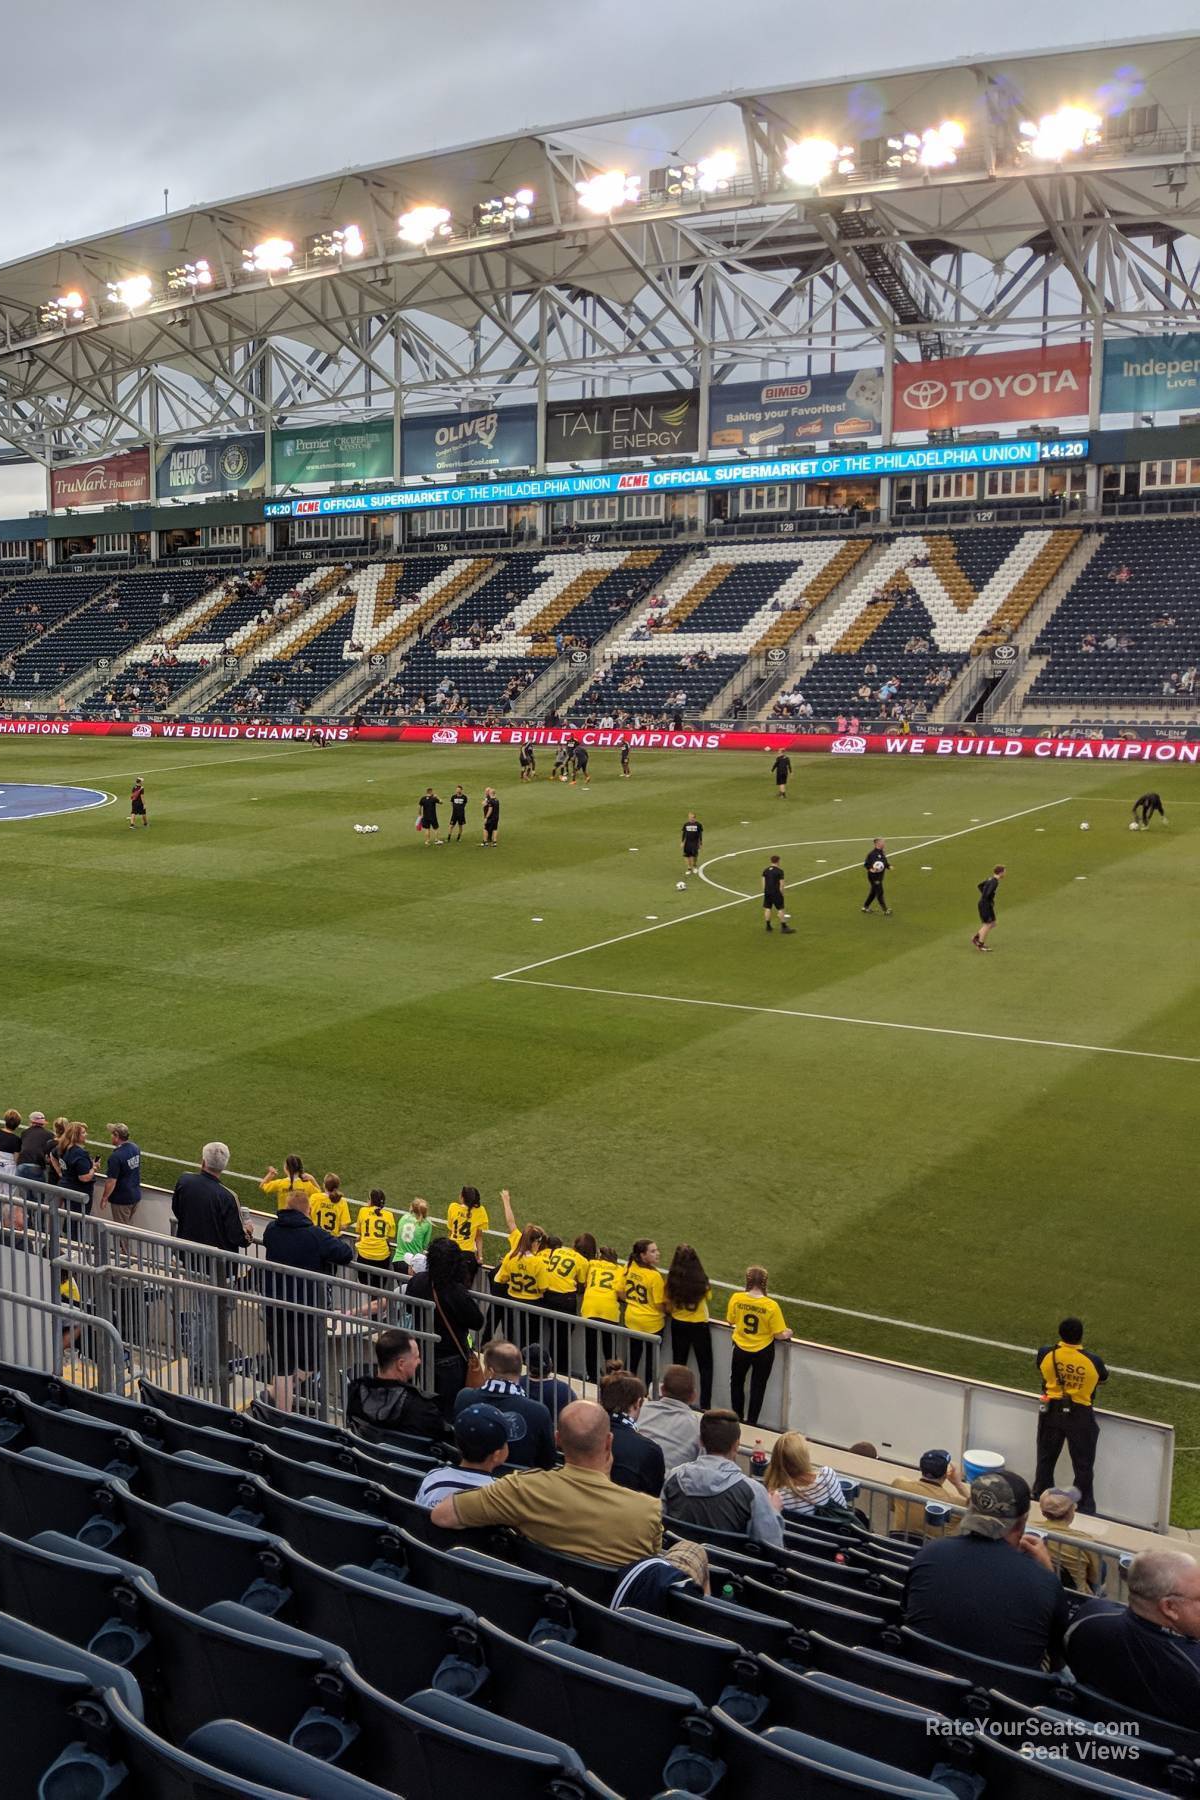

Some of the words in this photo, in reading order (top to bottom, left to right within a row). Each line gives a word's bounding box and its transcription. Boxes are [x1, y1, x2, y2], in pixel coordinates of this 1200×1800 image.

[765, 385, 808, 399] BIMBO
[951, 369, 1080, 403] TOYOTA
[1167, 379, 1197, 389] LIVE
[557, 405, 653, 438] TALEN
[726, 411, 762, 423] Baking
[764, 410, 789, 420] your
[791, 402, 847, 415] Favorites!
[435, 413, 498, 445] OLIVER
[296, 438, 329, 451] Premier
[612, 431, 682, 450] ENERGY
[169, 449, 206, 470] ACTION
[1041, 443, 1083, 458] 14:20
[55, 473, 107, 494] TruMark
[109, 477, 144, 489] Financial
[169, 466, 196, 487] NEWS
[297, 502, 319, 513] ACME
[323, 498, 367, 511] OFFICIAL
[370, 490, 449, 508] SUPERMARKET
[451, 490, 466, 501] OF
[468, 487, 490, 499] THE
[492, 478, 570, 497] PHILADELPHIA
[573, 478, 611, 491] UNION
[619, 475, 648, 488] ACME
[653, 469, 712, 485] OFFICIAL
[715, 460, 818, 481] SUPERMARKET
[821, 460, 840, 473] OF
[843, 456, 871, 471] THE
[874, 447, 978, 470] PHILADELPHIA
[982, 444, 1032, 461] UNION
[266, 506, 290, 515] 14:20
[976, 513, 992, 521] 129
[780, 524, 793, 532] 128
[301, 551, 313, 559] 125
[163, 726, 184, 736] WE
[191, 727, 239, 738] BUILD
[473, 731, 500, 742] WE
[886, 739, 923, 753] WE
[936, 740, 1023, 756] BUILD
[316, 1211, 337, 1231] 13
[364, 1219, 386, 1238] 19
[453, 1220, 473, 1240] 14
[402, 1223, 416, 1243] 8
[548, 1255, 576, 1278] 99
[511, 1273, 538, 1293] 52
[590, 1270, 615, 1289] 12
[626, 1280, 648, 1304] 29
[743, 1314, 759, 1334] 9
[1056, 1362, 1086, 1376] CSC
[1061, 1381, 1084, 1391] TAFF
